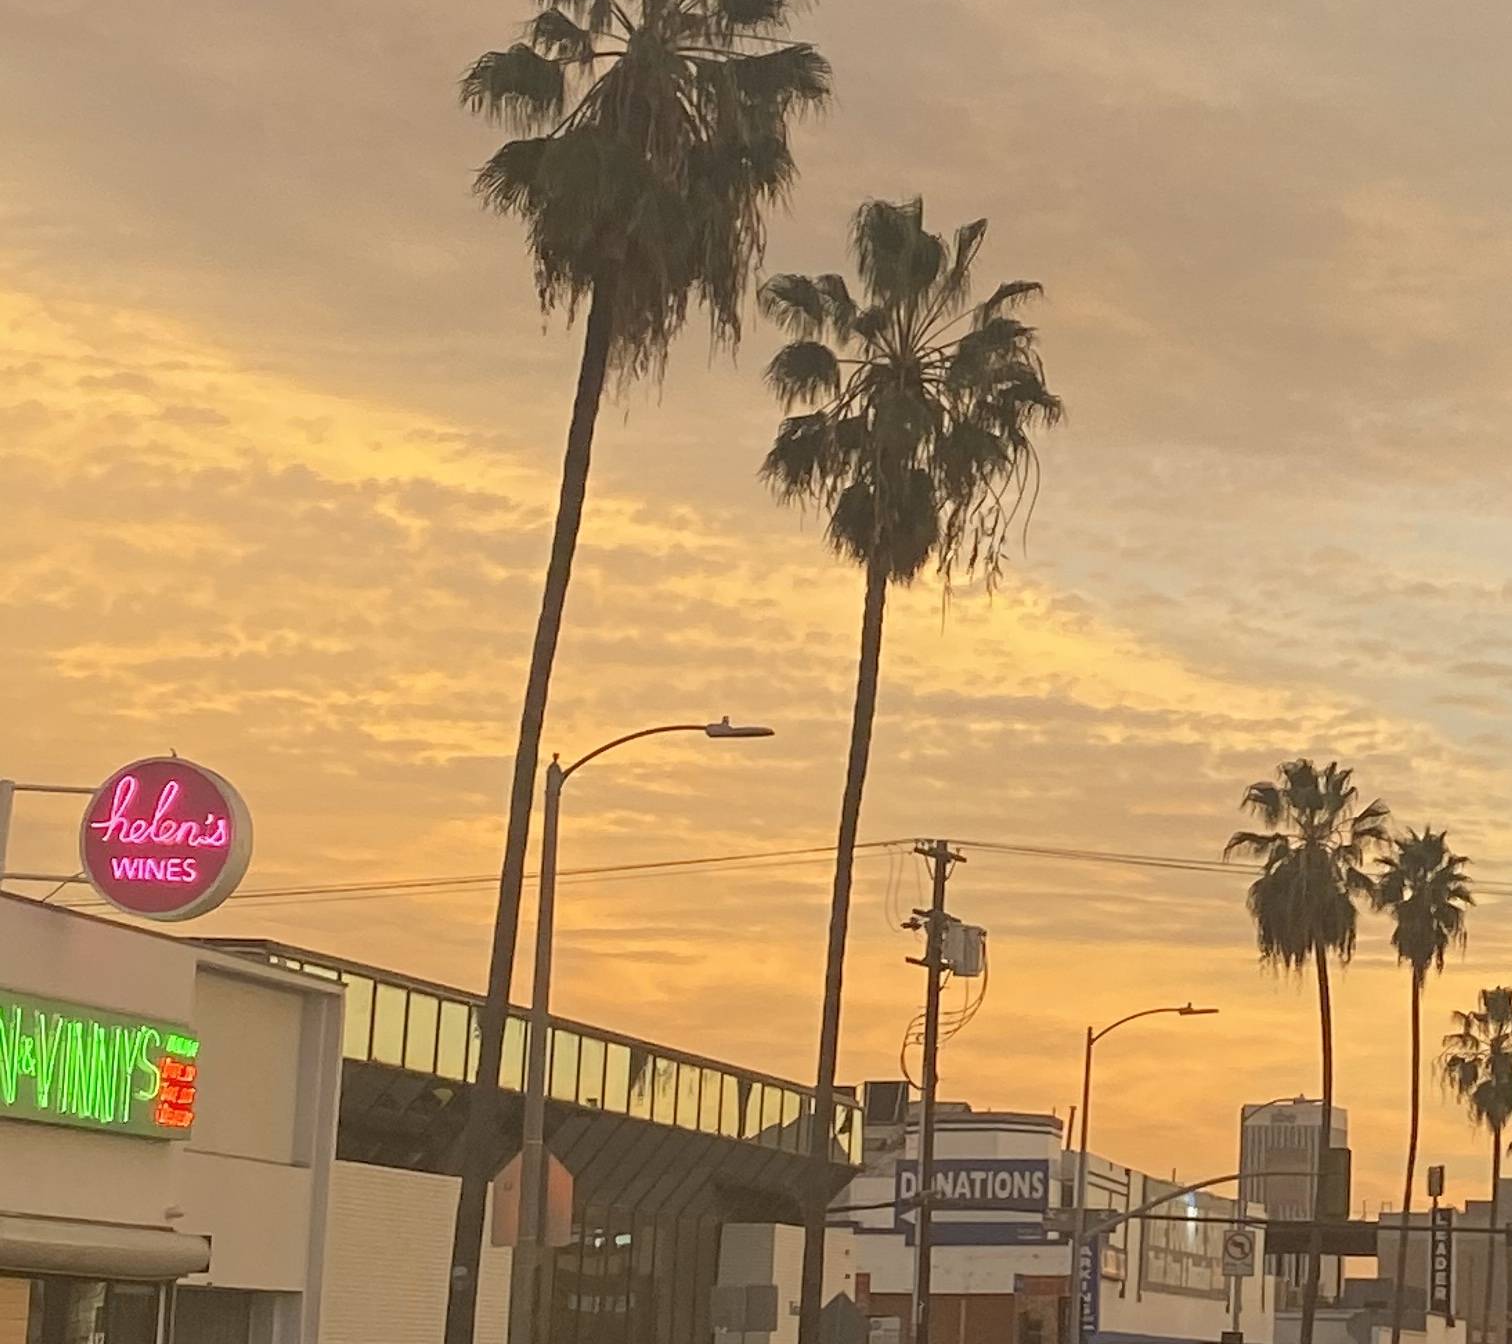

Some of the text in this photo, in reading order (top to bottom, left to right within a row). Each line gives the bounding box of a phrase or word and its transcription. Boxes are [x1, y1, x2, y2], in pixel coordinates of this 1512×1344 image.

[91, 775, 227, 846] helen's
[111, 857, 197, 882] WINES
[36, 1013, 161, 1123] VINNY'S
[901, 1170, 1045, 1199] DNATIONS
[1435, 1212, 1448, 1301] LEADER
